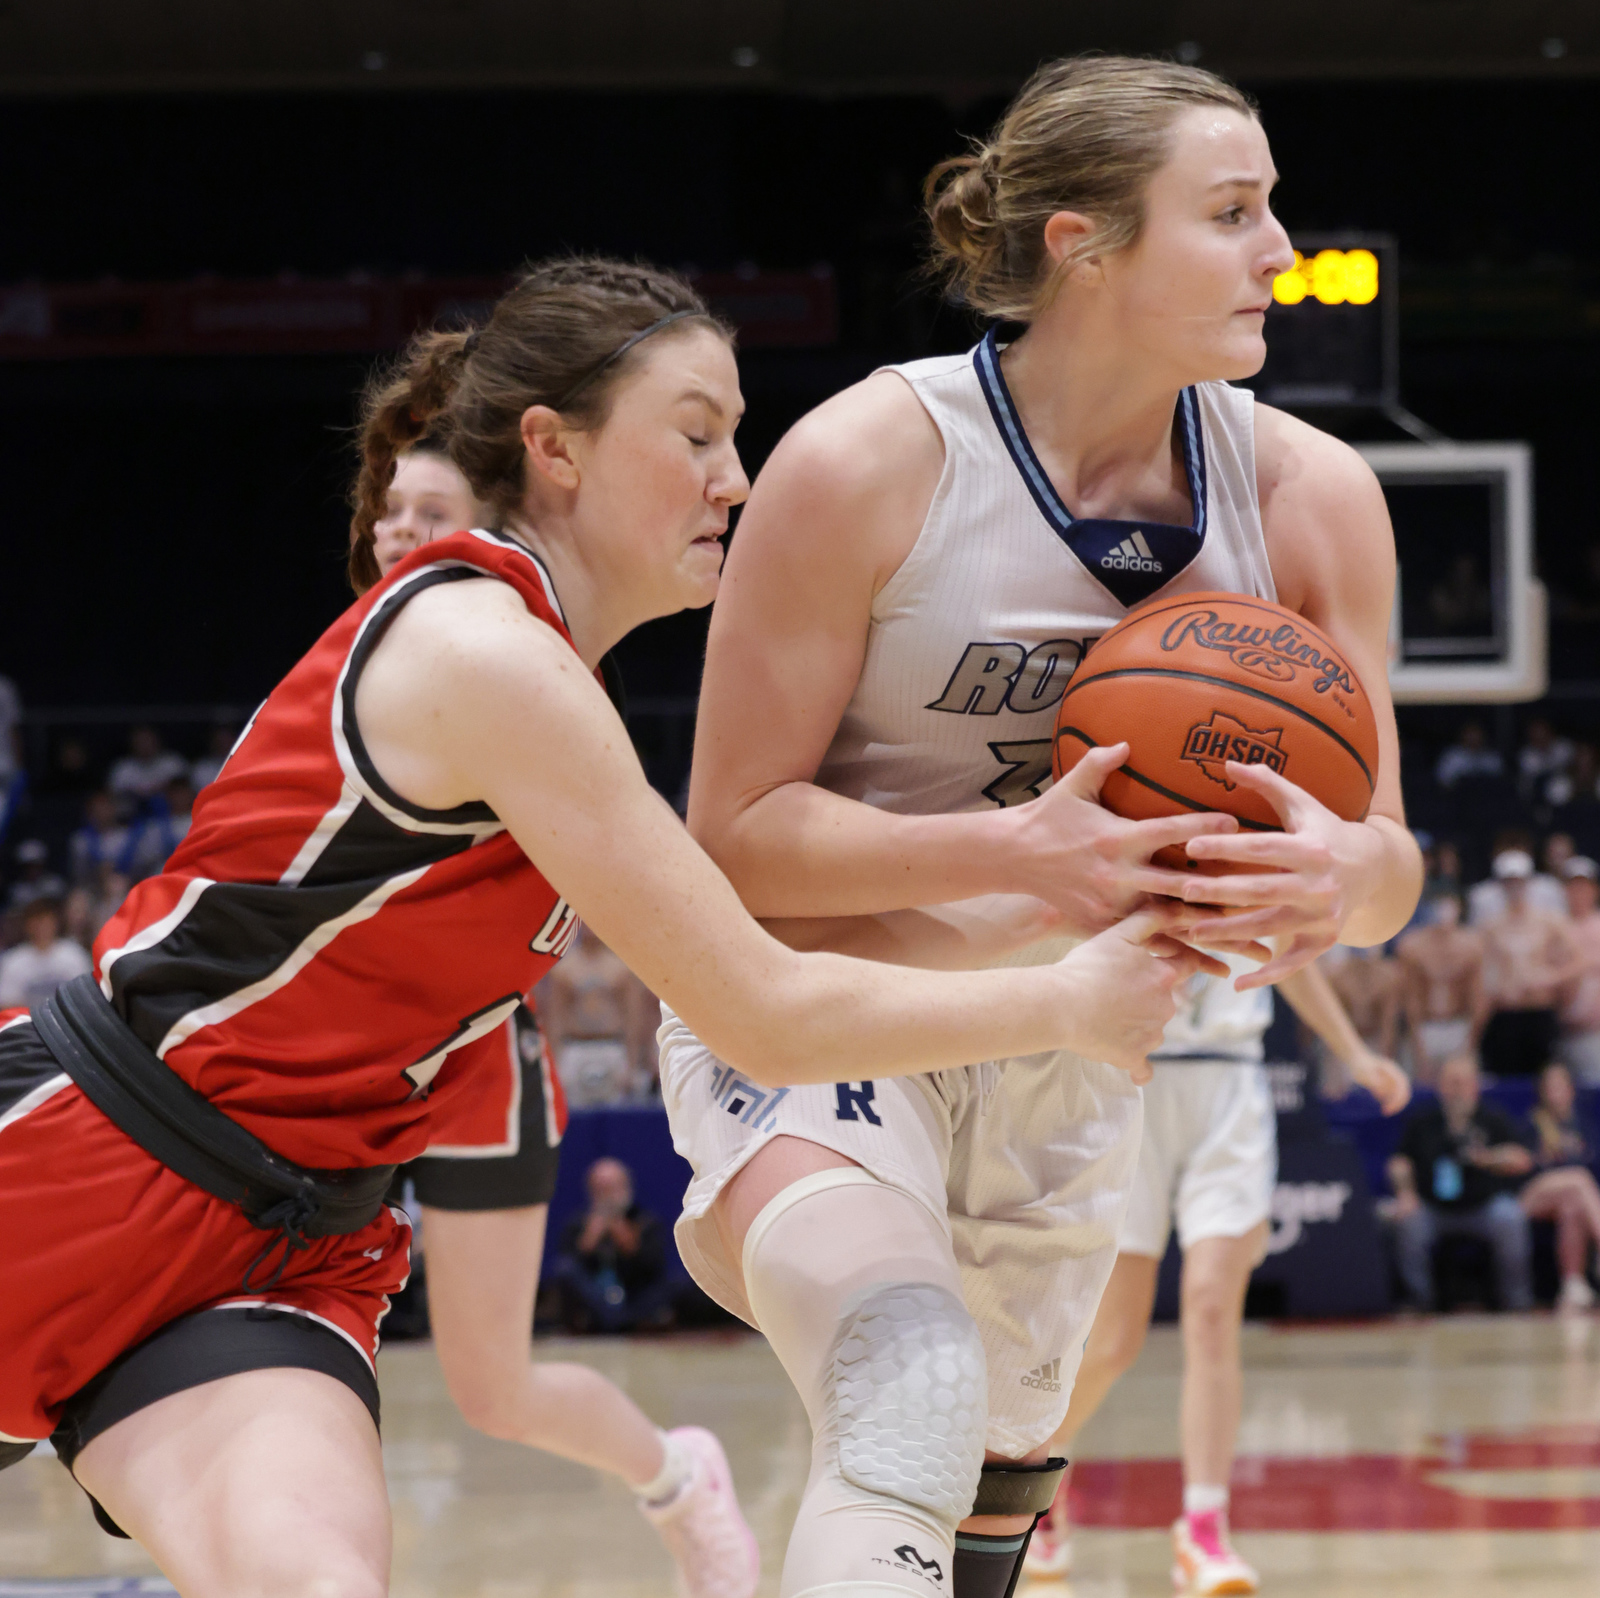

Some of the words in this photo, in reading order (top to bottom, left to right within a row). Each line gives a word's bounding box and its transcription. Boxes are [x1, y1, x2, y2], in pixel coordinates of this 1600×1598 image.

[1101, 555, 1163, 573] adidas
[1160, 610, 1355, 694] Rawlings
[924, 637, 1101, 716] RO
[834, 1080, 884, 1128] R
[1020, 1375, 1062, 1393] adidas
